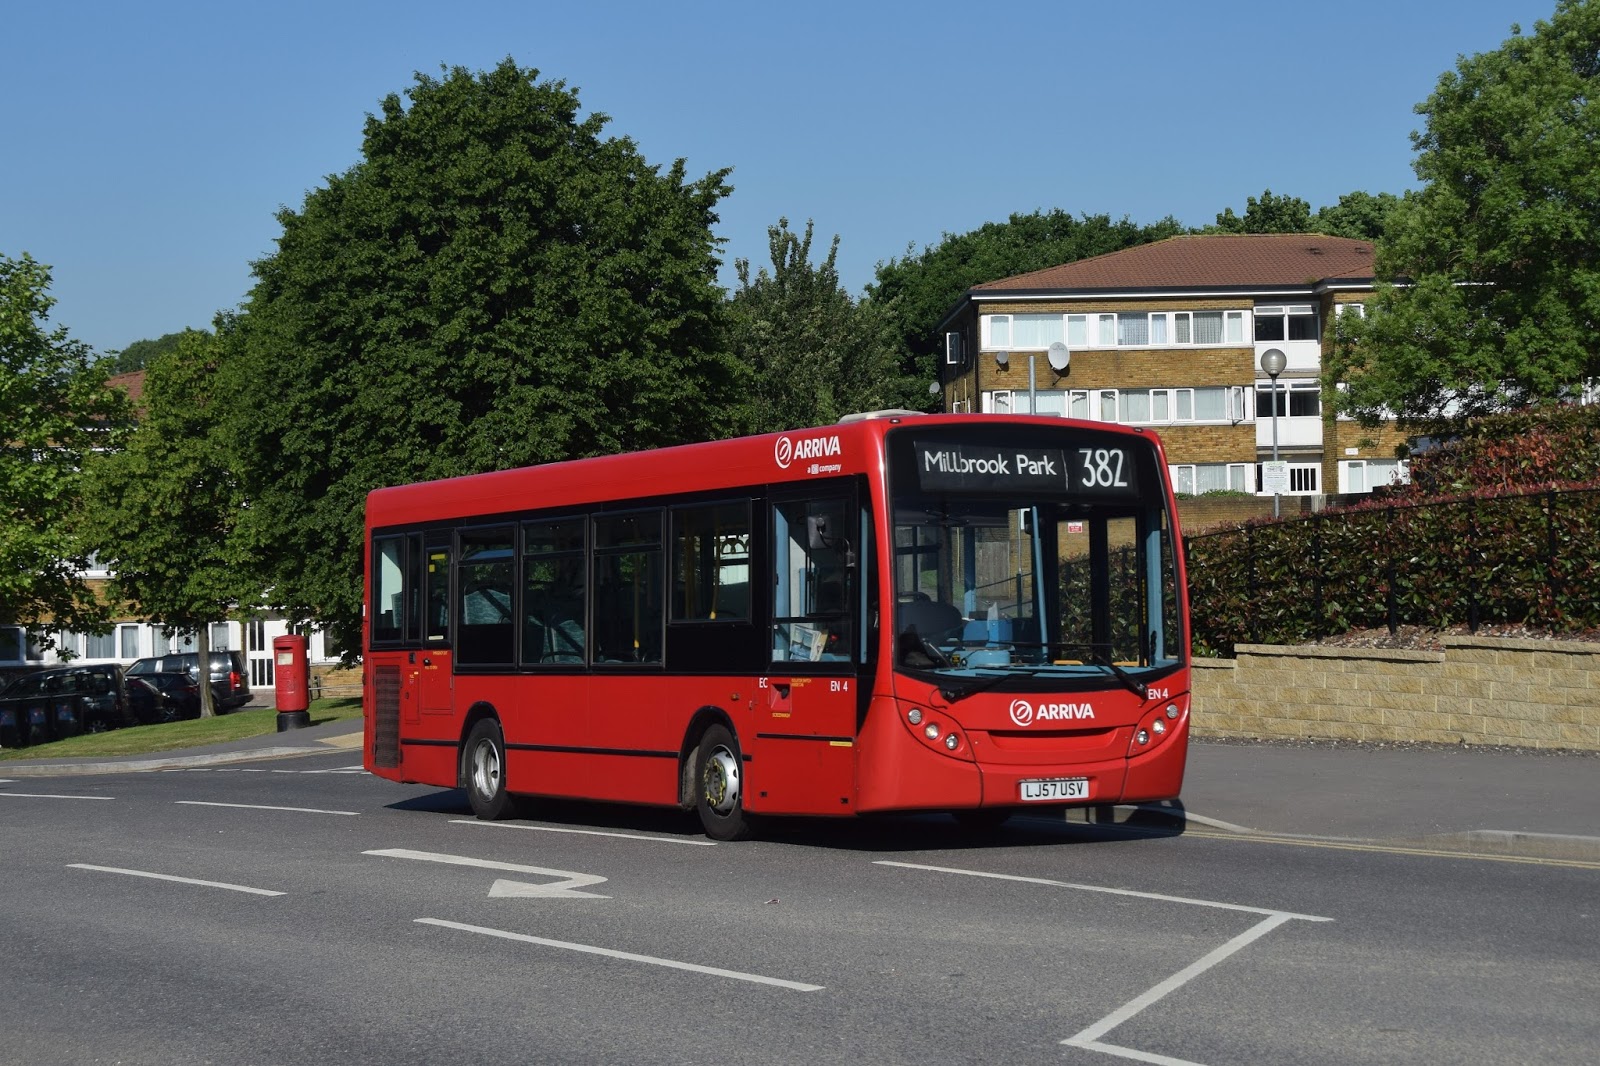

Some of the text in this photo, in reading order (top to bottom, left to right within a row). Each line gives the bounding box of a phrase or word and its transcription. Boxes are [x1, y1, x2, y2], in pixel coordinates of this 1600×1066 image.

[793, 436, 841, 459] ARRIVA
[924, 450, 1057, 476] Millbrook Park
[1079, 449, 1128, 488] 382
[759, 677, 768, 689] EC
[831, 681, 848, 692] EN 4
[1148, 688, 1169, 699] EN 4
[1036, 703, 1095, 720] ARRIVA
[1026, 782, 1083, 798] LJ57 USV
